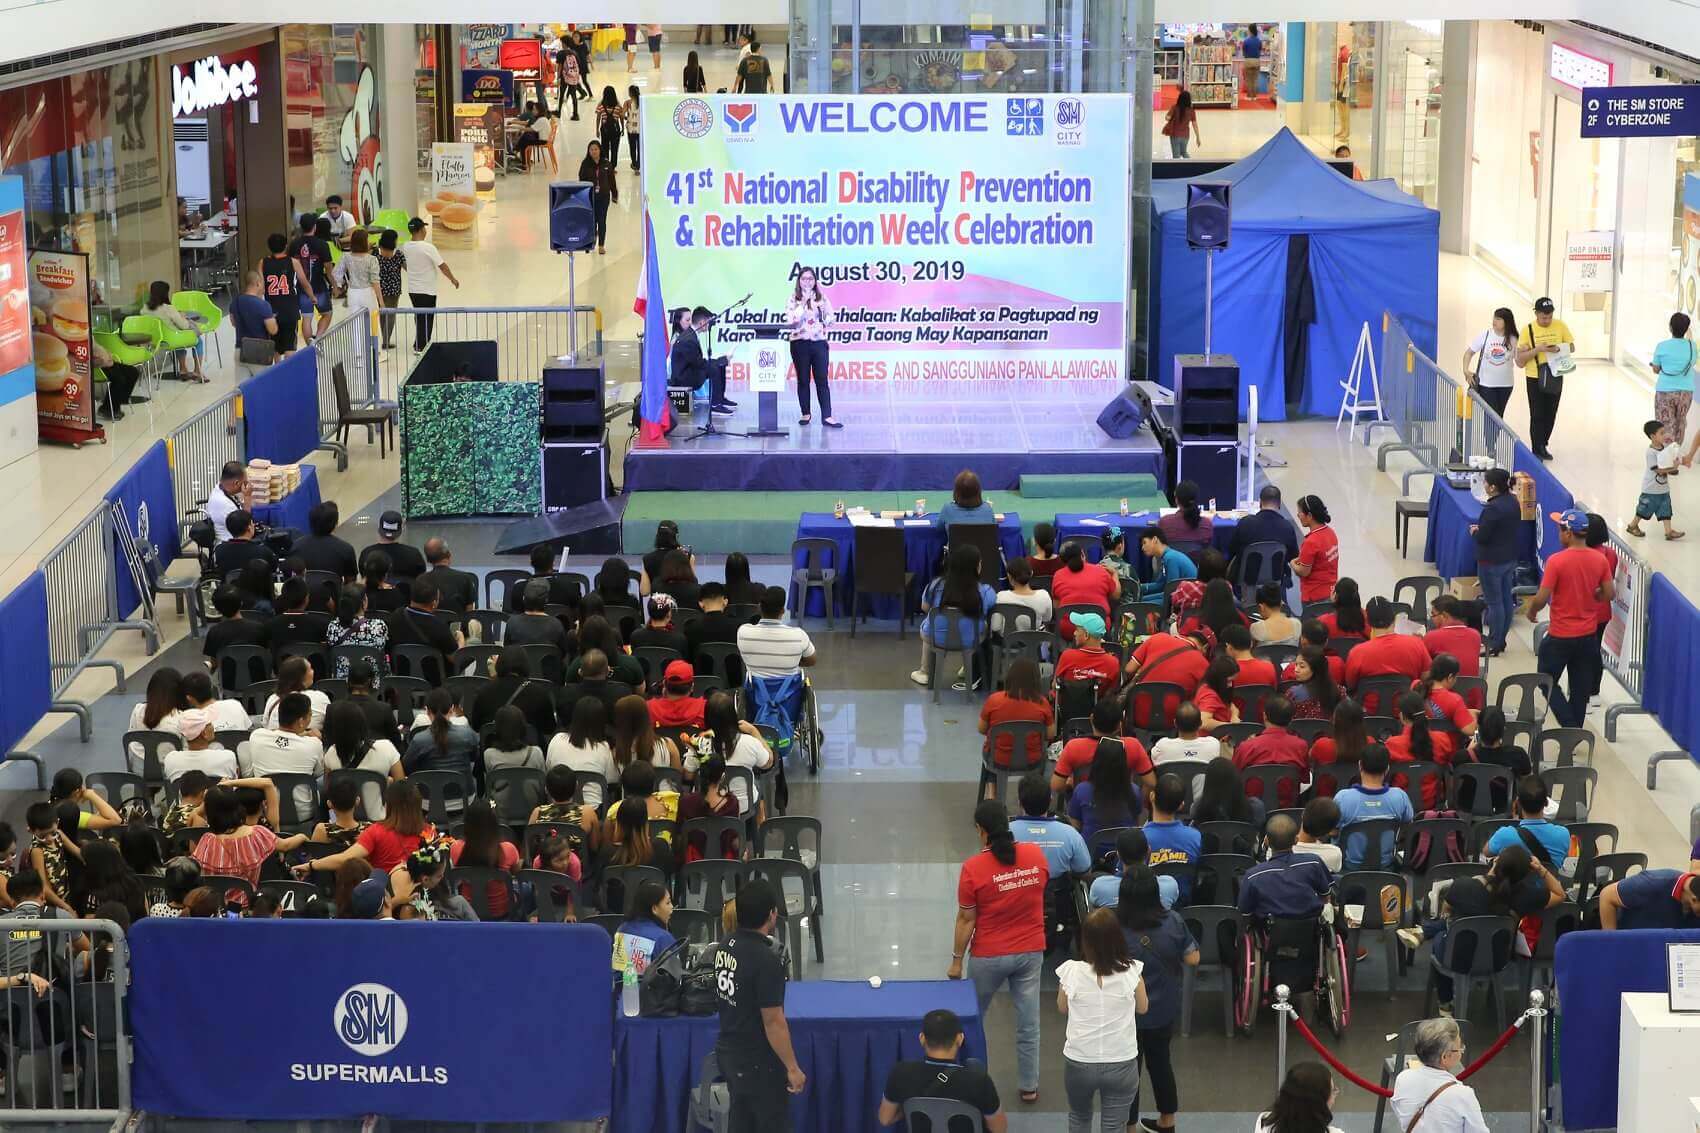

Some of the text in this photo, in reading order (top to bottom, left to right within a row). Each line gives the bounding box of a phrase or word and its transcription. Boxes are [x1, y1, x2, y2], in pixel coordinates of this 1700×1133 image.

[1057, 100, 1082, 125] SM
[1607, 98, 1685, 111] THE SM STORE
[779, 101, 989, 134] WELCOME
[1587, 113, 1672, 127] 2F CYBERZONE
[1057, 132, 1081, 141] CITY
[666, 168, 1092, 213] 41st National Disability Prevention
[675, 212, 1094, 247] & Rehabilitation Week Celebration
[36, 264, 75, 276] Breakfast
[875, 261, 907, 284] 30,
[912, 260, 965, 281] 2019
[266, 274, 290, 295] 24
[725, 308, 769, 324] Lokal
[834, 307, 897, 323] halaan:
[900, 307, 976, 322] Kabalikat
[979, 310, 995, 322] sa
[999, 305, 1077, 324] Pagtupad
[1079, 310, 1099, 324] ng
[827, 331, 862, 343] mga
[866, 327, 912, 343] Taong
[916, 327, 949, 343] May
[952, 326, 1048, 342] Kapansanan
[893, 360, 920, 380] AND
[922, 359, 1016, 380] SANGGUNIANG
[1018, 359, 1118, 380] PANLALAWIGAN
[340, 990, 396, 1045] SM
[290, 1063, 449, 1085] SUPERMALLS
